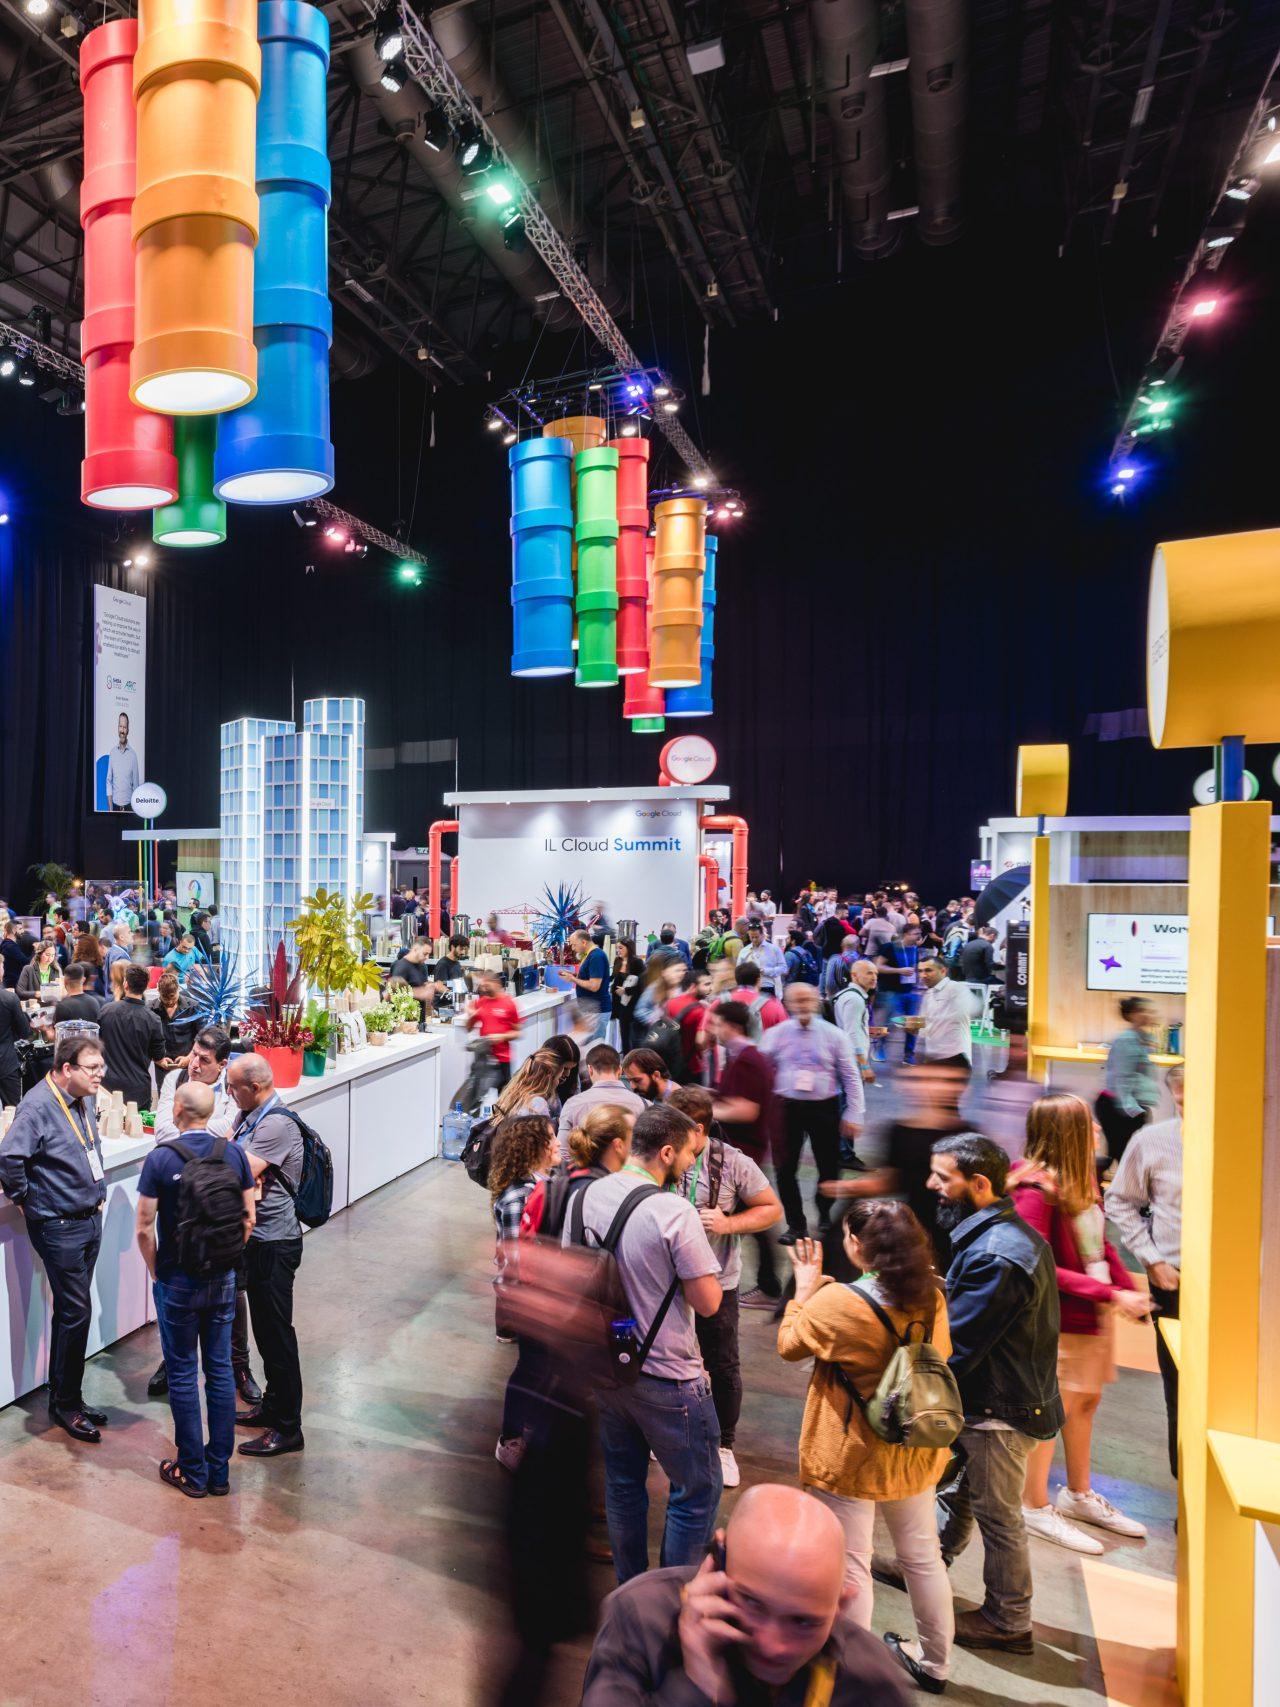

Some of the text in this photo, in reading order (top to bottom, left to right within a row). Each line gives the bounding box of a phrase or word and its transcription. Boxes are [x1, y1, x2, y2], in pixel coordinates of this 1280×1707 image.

[671, 755, 693, 763] Google
[636, 810, 661, 818] Google
[545, 838, 681, 852] IL Cloud Summit
